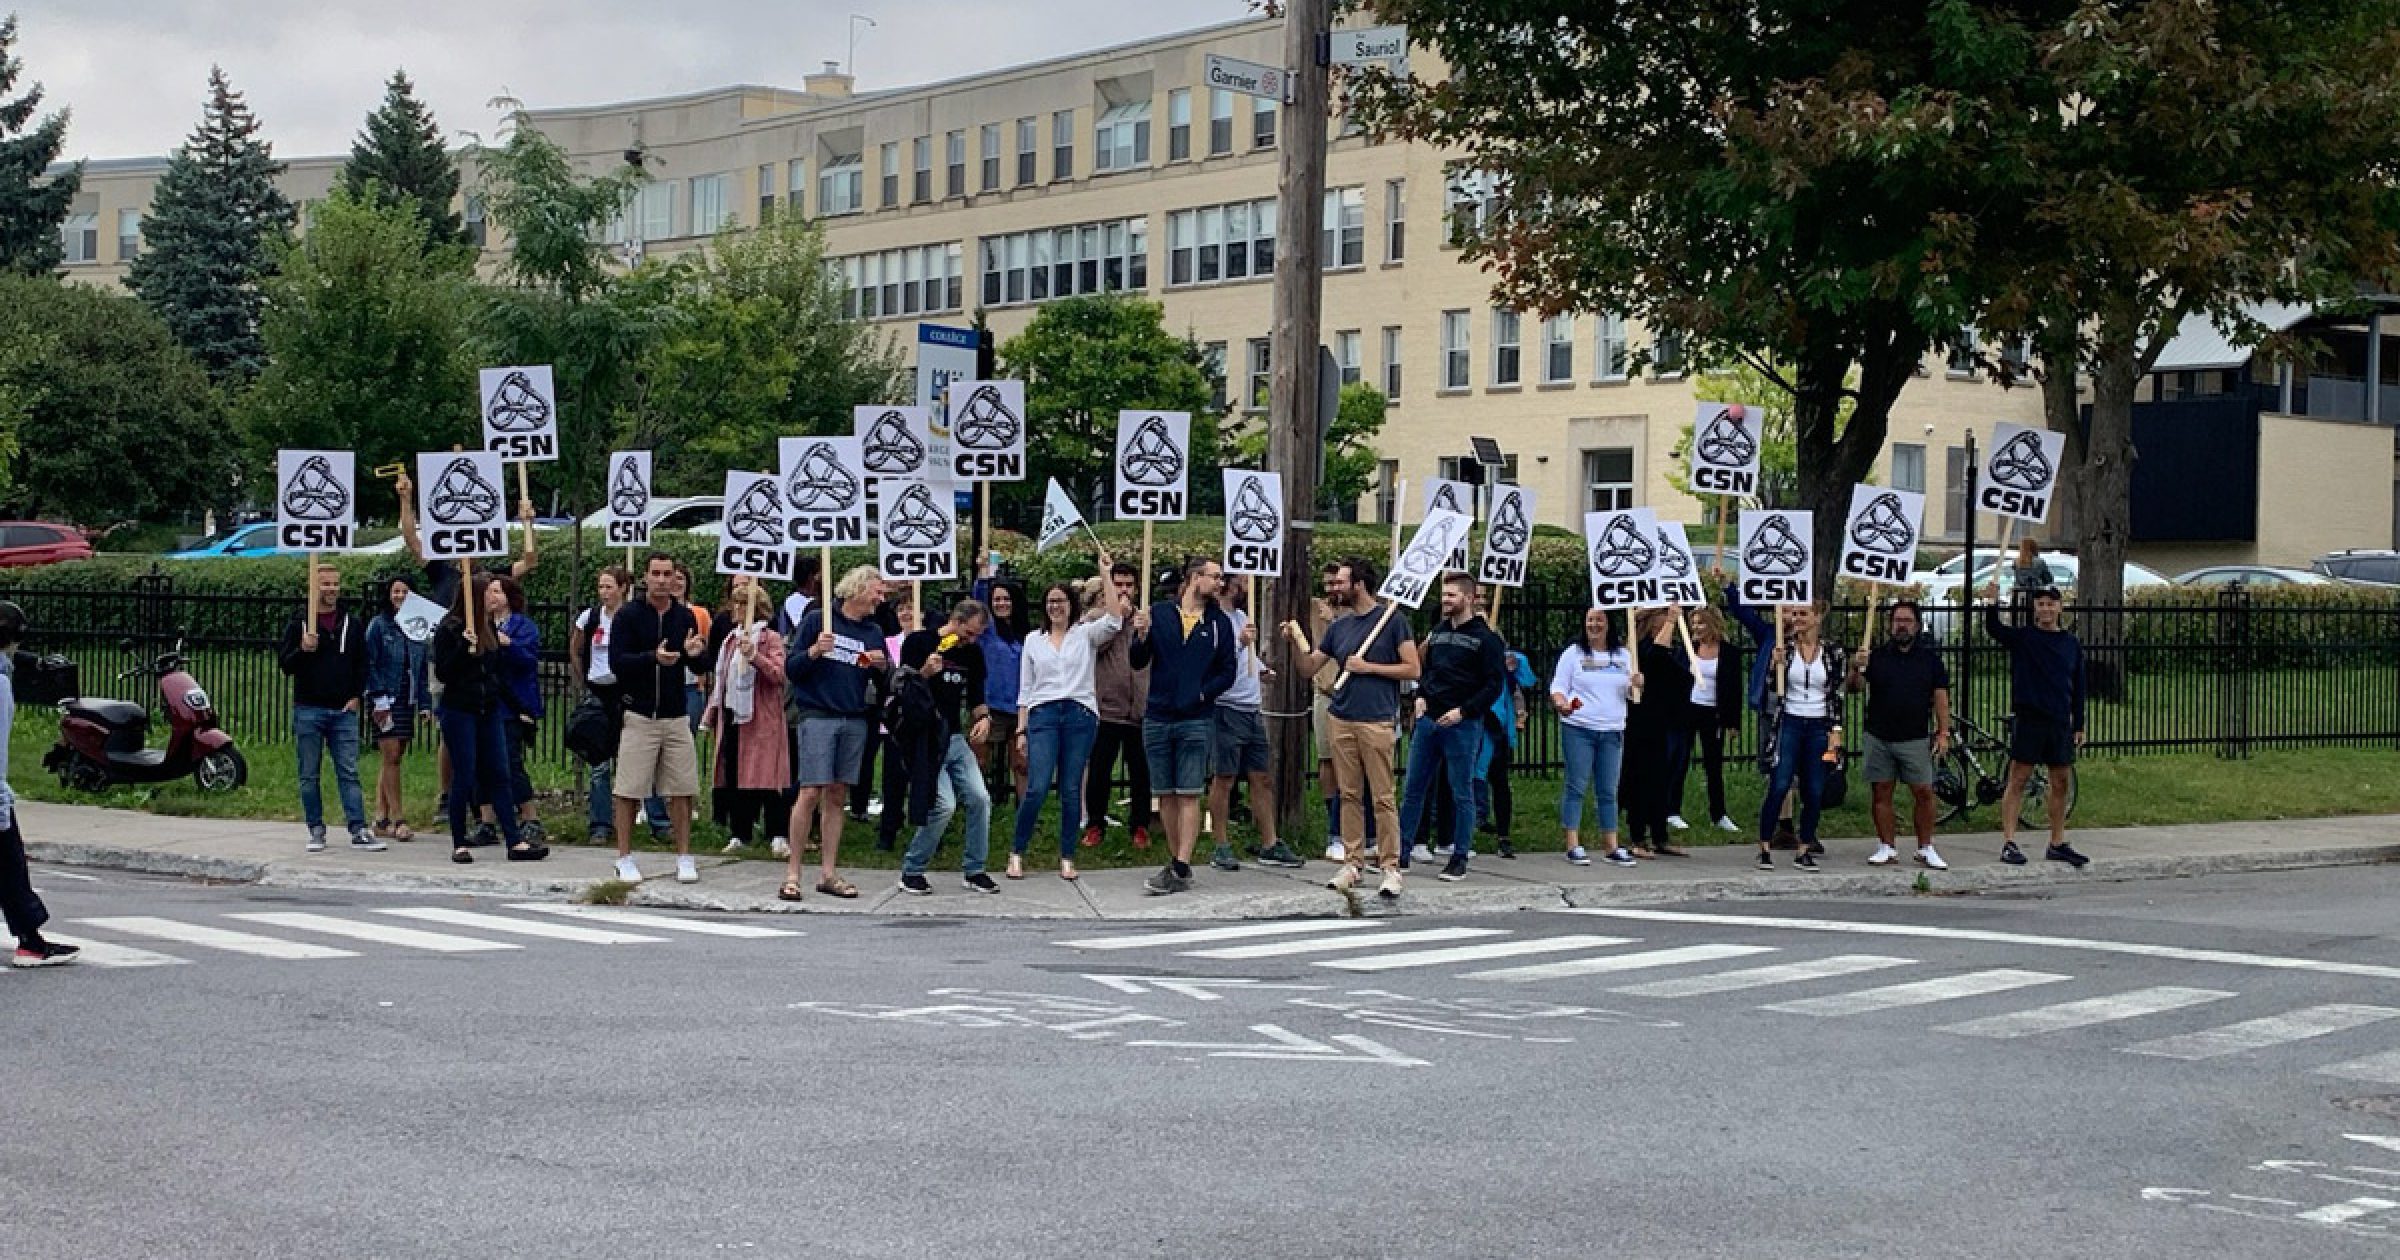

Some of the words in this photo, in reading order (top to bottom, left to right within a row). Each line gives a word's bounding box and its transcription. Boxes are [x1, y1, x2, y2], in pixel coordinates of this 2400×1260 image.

[1355, 38, 1401, 57] Sauriol
[1211, 66, 1257, 91] Garnier
[953, 453, 1021, 477] CSN
[1696, 467, 1753, 494] CSN
[1119, 489, 1183, 516] CSN
[1982, 487, 2046, 518] CSN
[281, 523, 348, 548] CSN
[429, 527, 503, 555] CSN
[609, 519, 649, 544] CSN
[787, 515, 861, 543] CSN
[723, 546, 790, 576] CSN
[885, 551, 951, 577] CSN
[1229, 544, 1279, 572] CSN
[1483, 555, 1523, 583] CSN
[1846, 551, 1909, 581] CSN
[1384, 572, 1425, 602] CSN
[1597, 576, 1658, 605] CSN
[1661, 580, 1701, 603] SN
[1743, 576, 1809, 602] CSN
